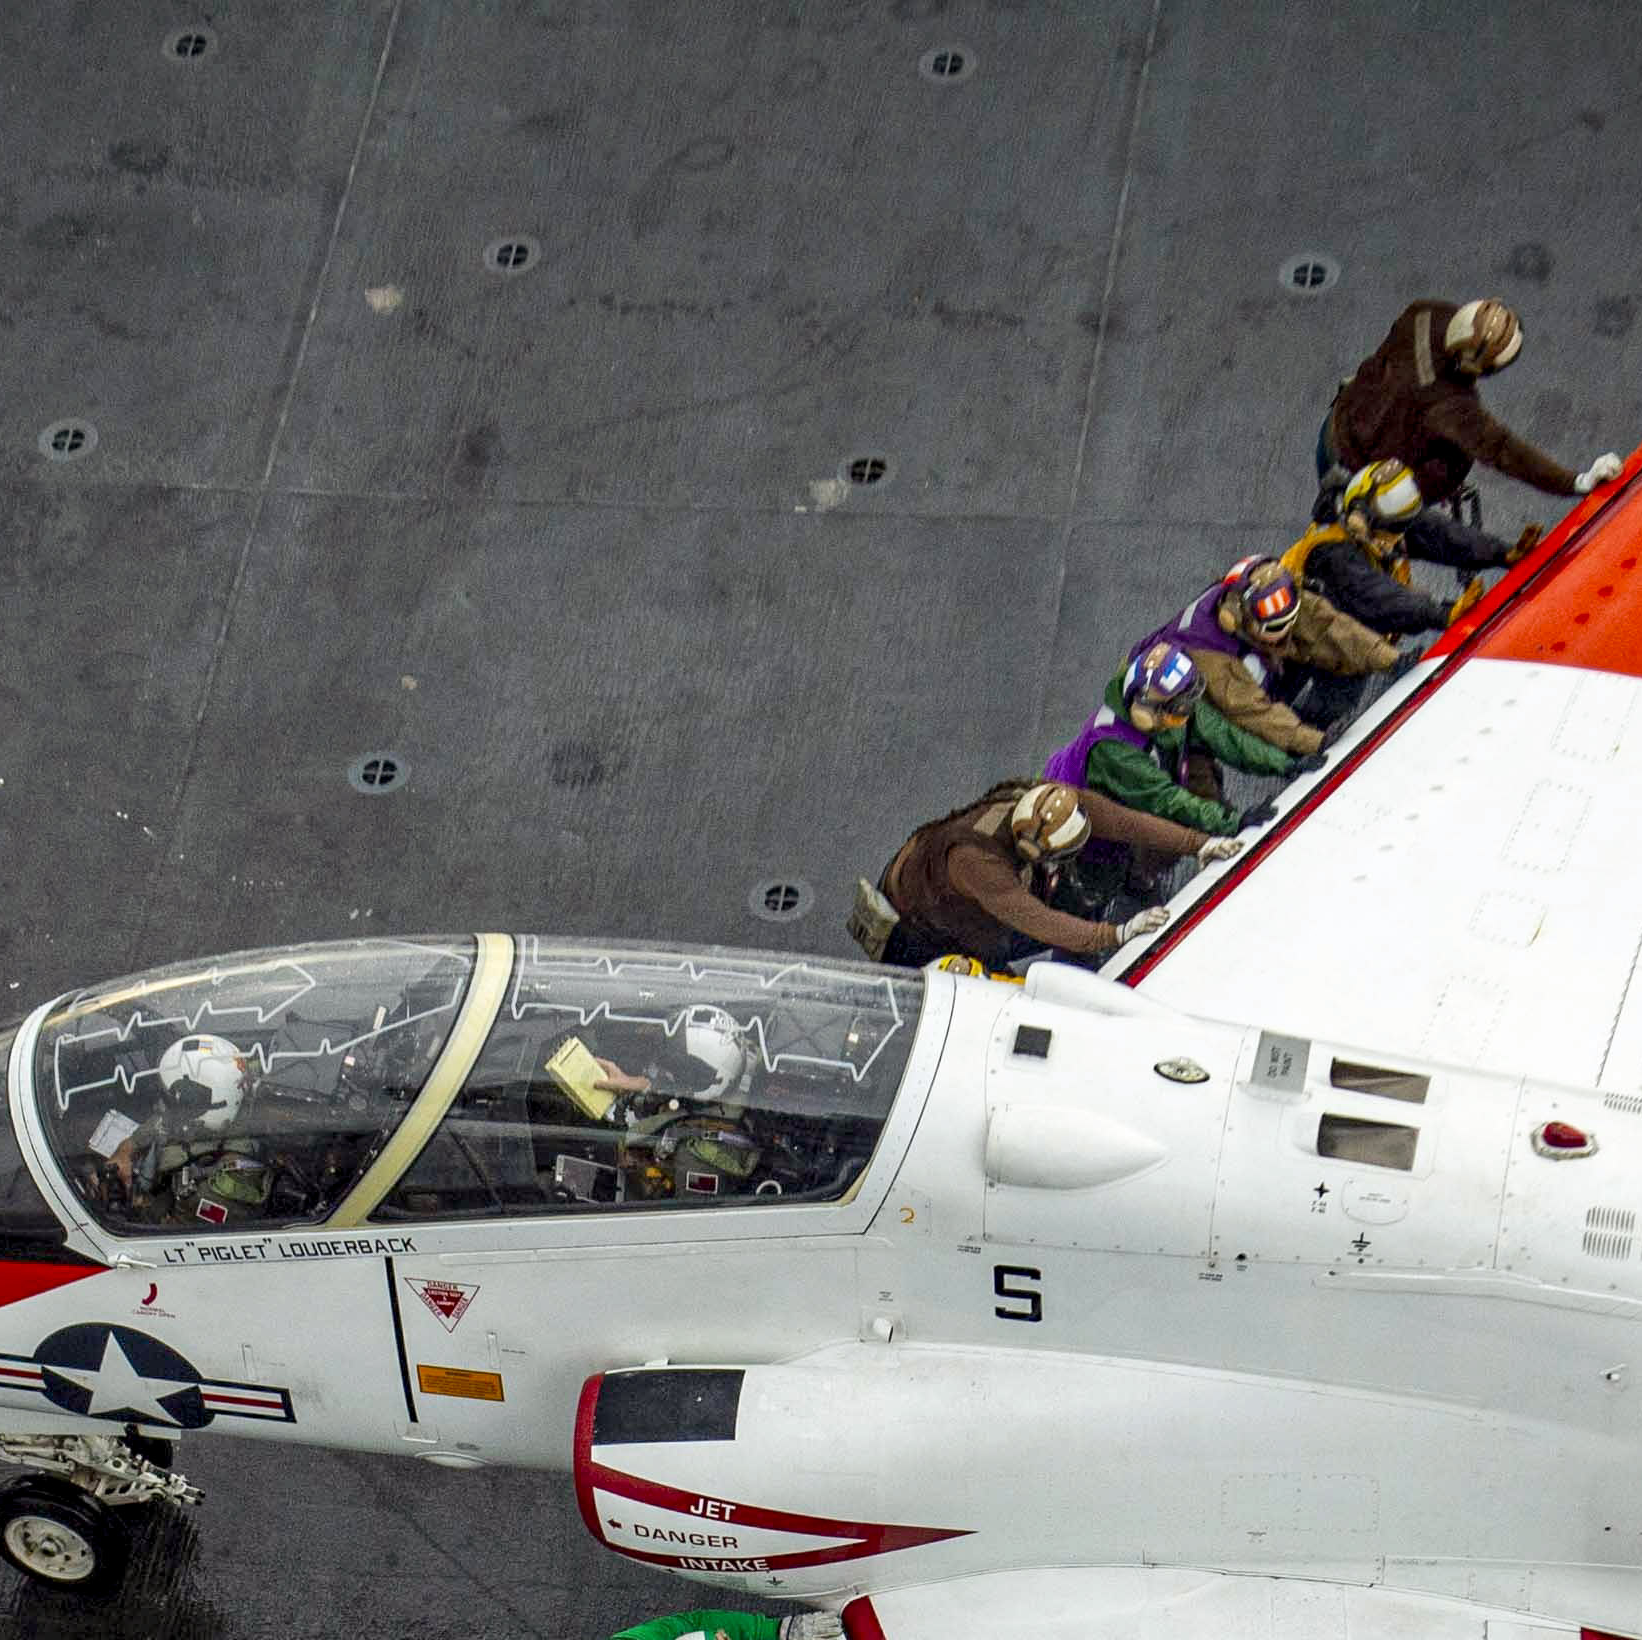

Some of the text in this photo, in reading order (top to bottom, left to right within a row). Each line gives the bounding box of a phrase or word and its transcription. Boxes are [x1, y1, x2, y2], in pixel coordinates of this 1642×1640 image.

[899, 1207, 916, 1223] 2
[164, 1248, 187, 1264] LT
[278, 1237, 418, 1258] LOUDERBACK
[690, 1498, 737, 1521] JET
[634, 1524, 739, 1549] DANGER
[679, 1557, 771, 1572] INTAKE
